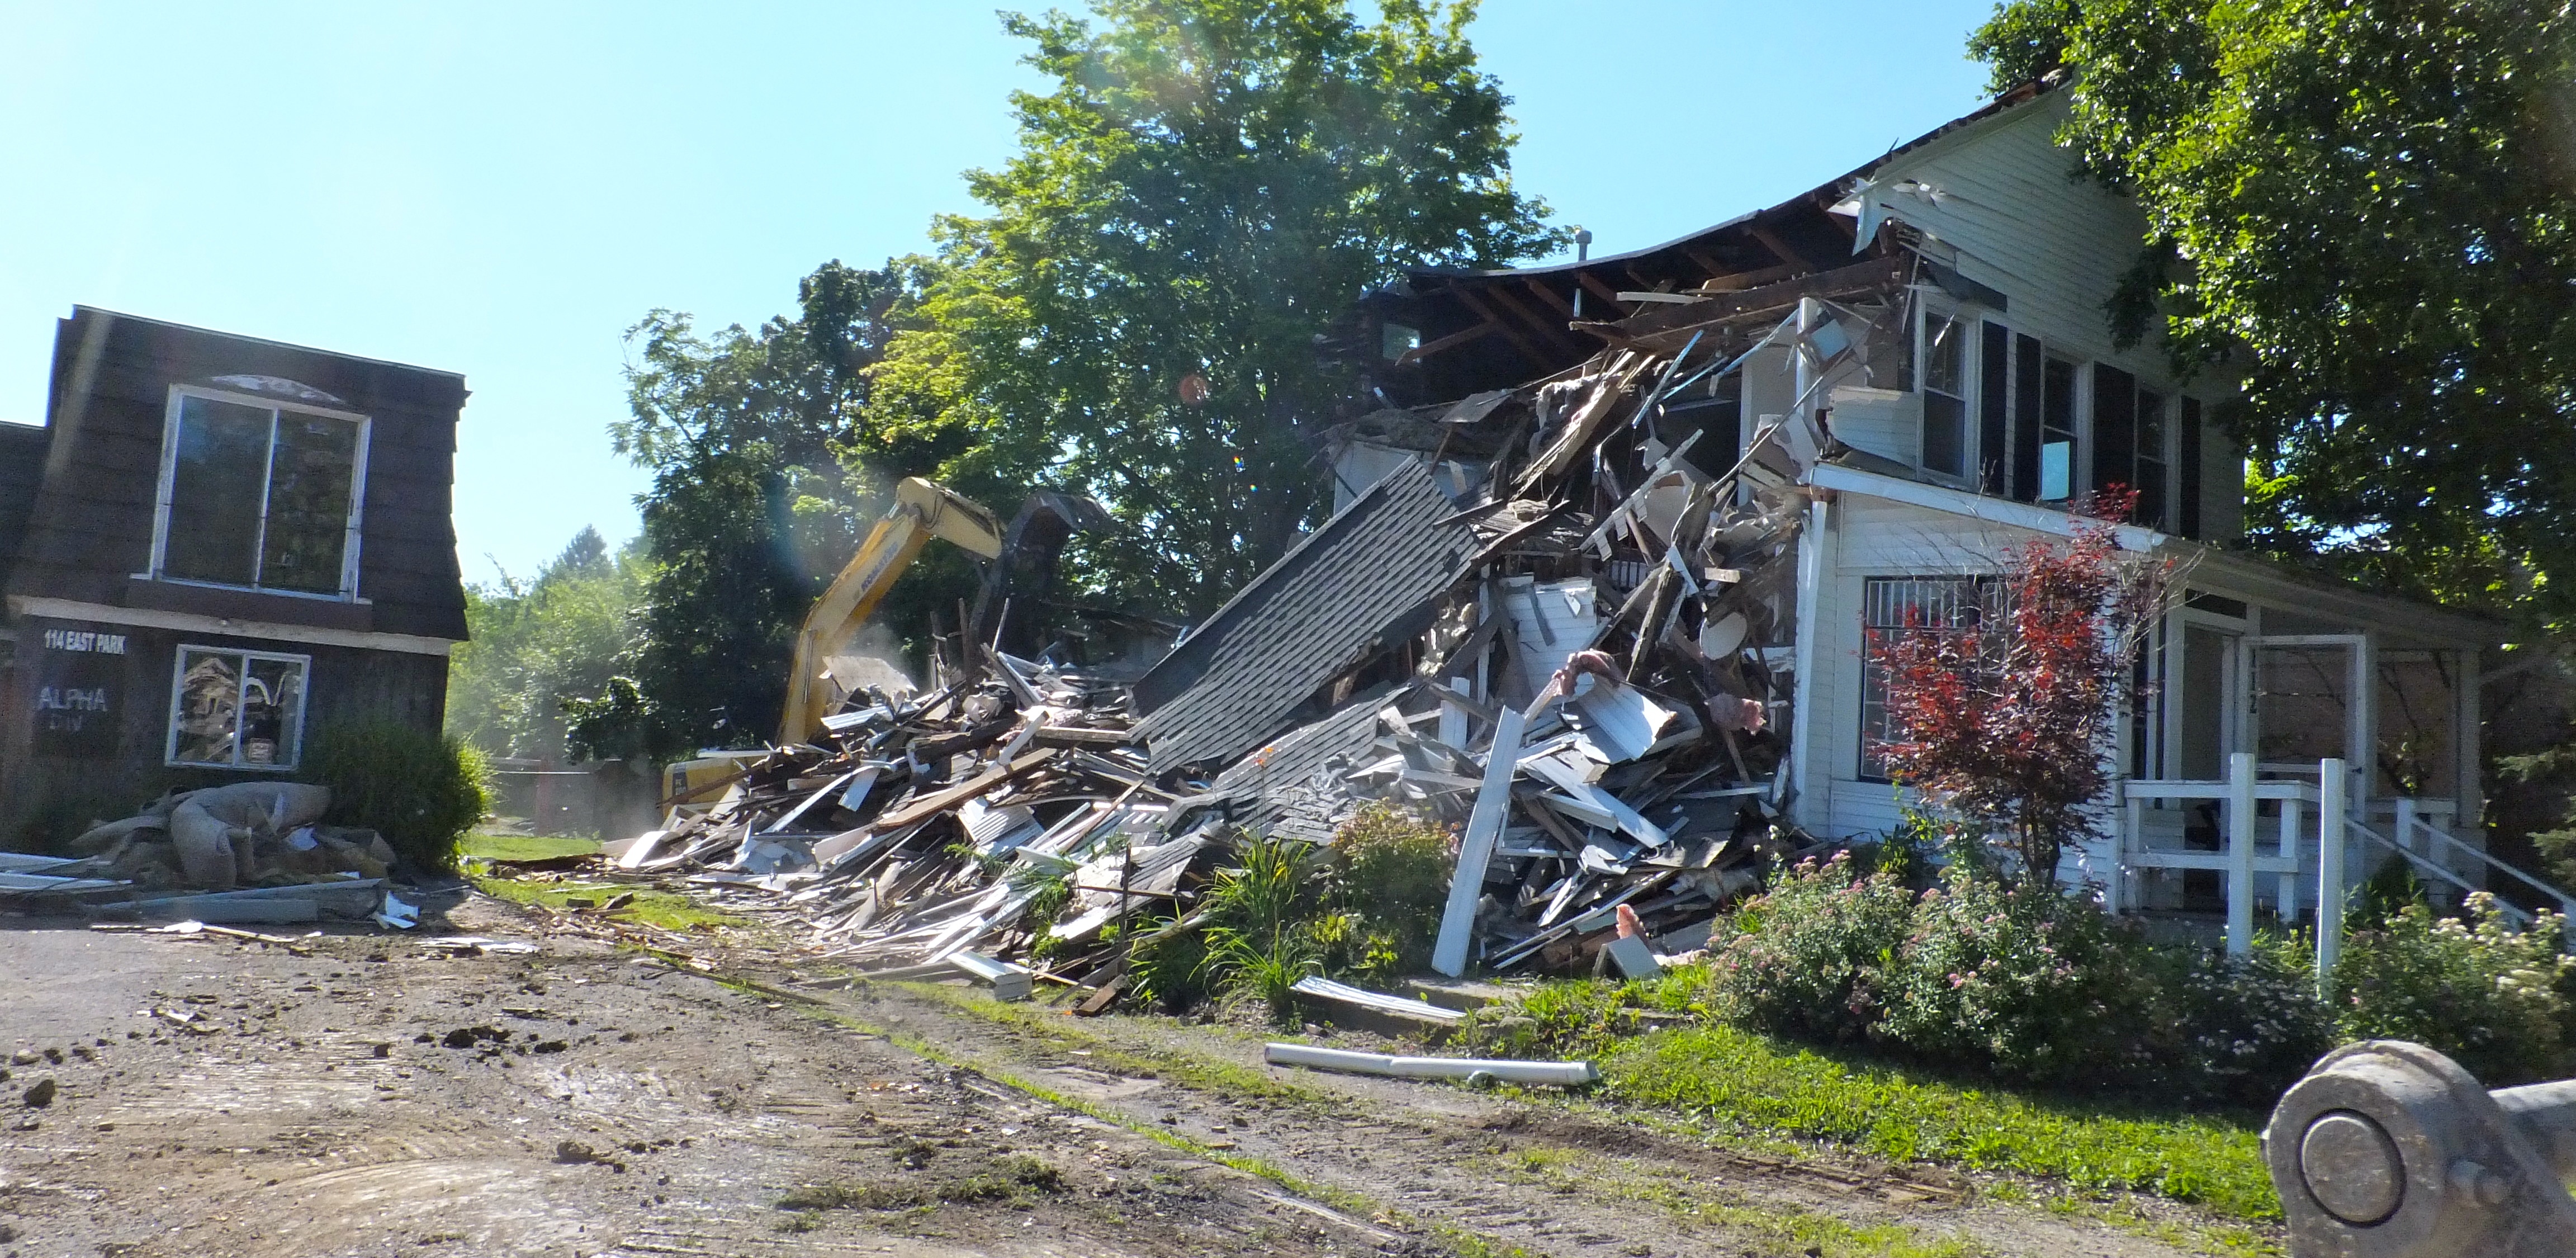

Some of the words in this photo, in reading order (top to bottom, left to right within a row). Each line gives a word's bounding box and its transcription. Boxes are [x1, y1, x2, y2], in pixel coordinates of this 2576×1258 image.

[45, 630, 64, 649] 114
[66, 631, 96, 651] EAST
[97, 634, 126, 654] PARK
[38, 686, 107, 712] ALPHA
